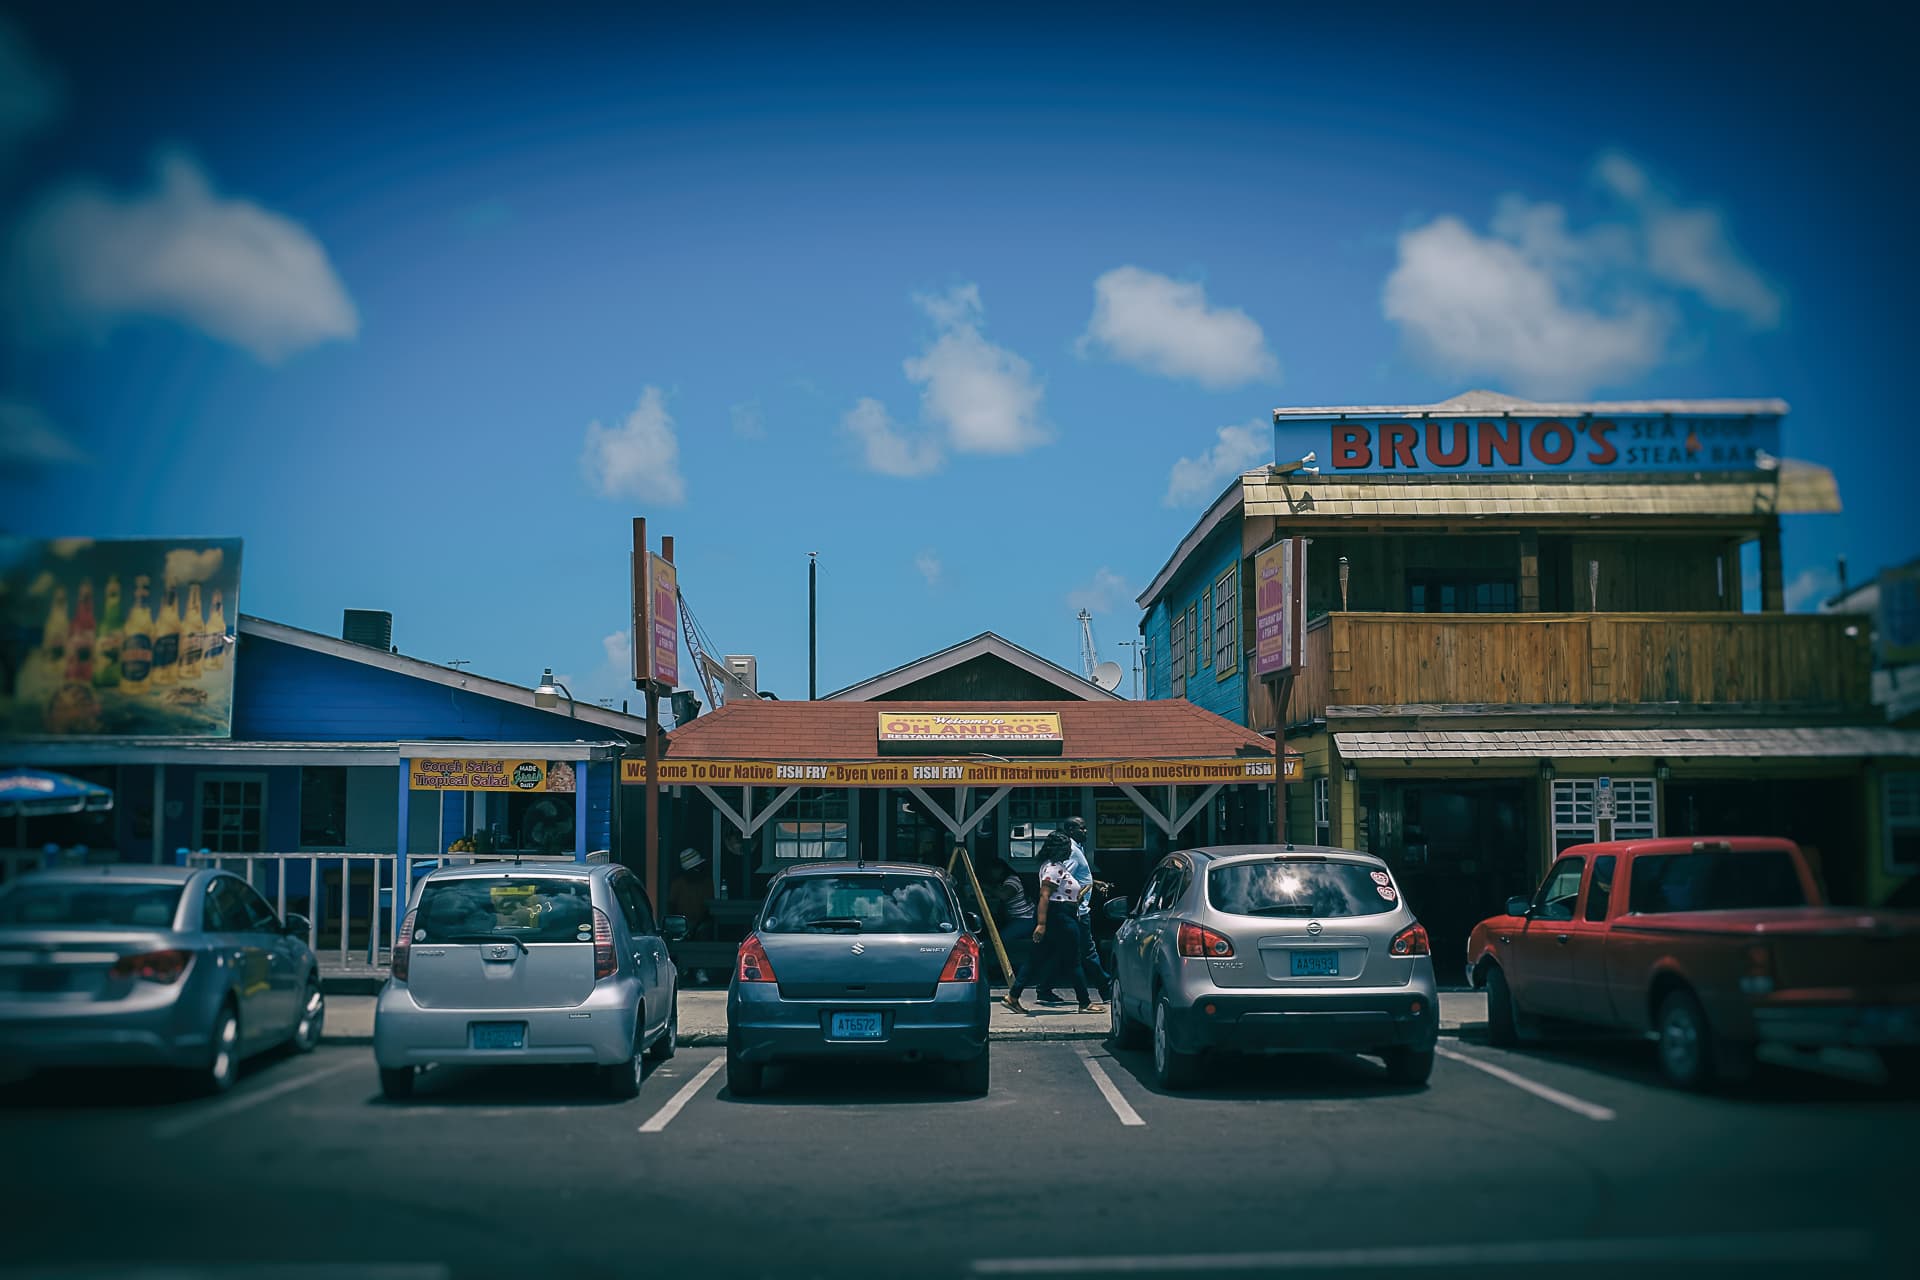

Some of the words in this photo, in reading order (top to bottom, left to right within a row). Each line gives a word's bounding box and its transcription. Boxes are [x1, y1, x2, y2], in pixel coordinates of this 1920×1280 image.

[1631, 421, 1676, 439] SEA
[1330, 421, 1619, 469] BRUNO'S
[1626, 446, 1699, 464] STEAK
[932, 716, 990, 725] Welcome
[991, 717, 1005, 725] to
[941, 724, 1052, 734] ANDROS
[421, 760, 463, 773] Conch
[465, 760, 504, 773] Salad
[627, 763, 688, 778] Weome
[691, 764, 706, 778] To
[709, 764, 732, 778] Our
[734, 764, 774, 779] Native
[776, 765, 805, 779] FISH
[805, 765, 829, 779] FRY
[836, 766, 868, 781] Byen
[871, 766, 898, 780] veni
[901, 768, 908, 780] a
[913, 766, 940, 780] FISH
[941, 766, 964, 780] FRY
[1152, 764, 1201, 778] nuestro
[1245, 762, 1272, 776] FISH
[414, 773, 469, 789] Tropical
[471, 774, 510, 787] Salad
[838, 1018, 875, 1031] AT6572
